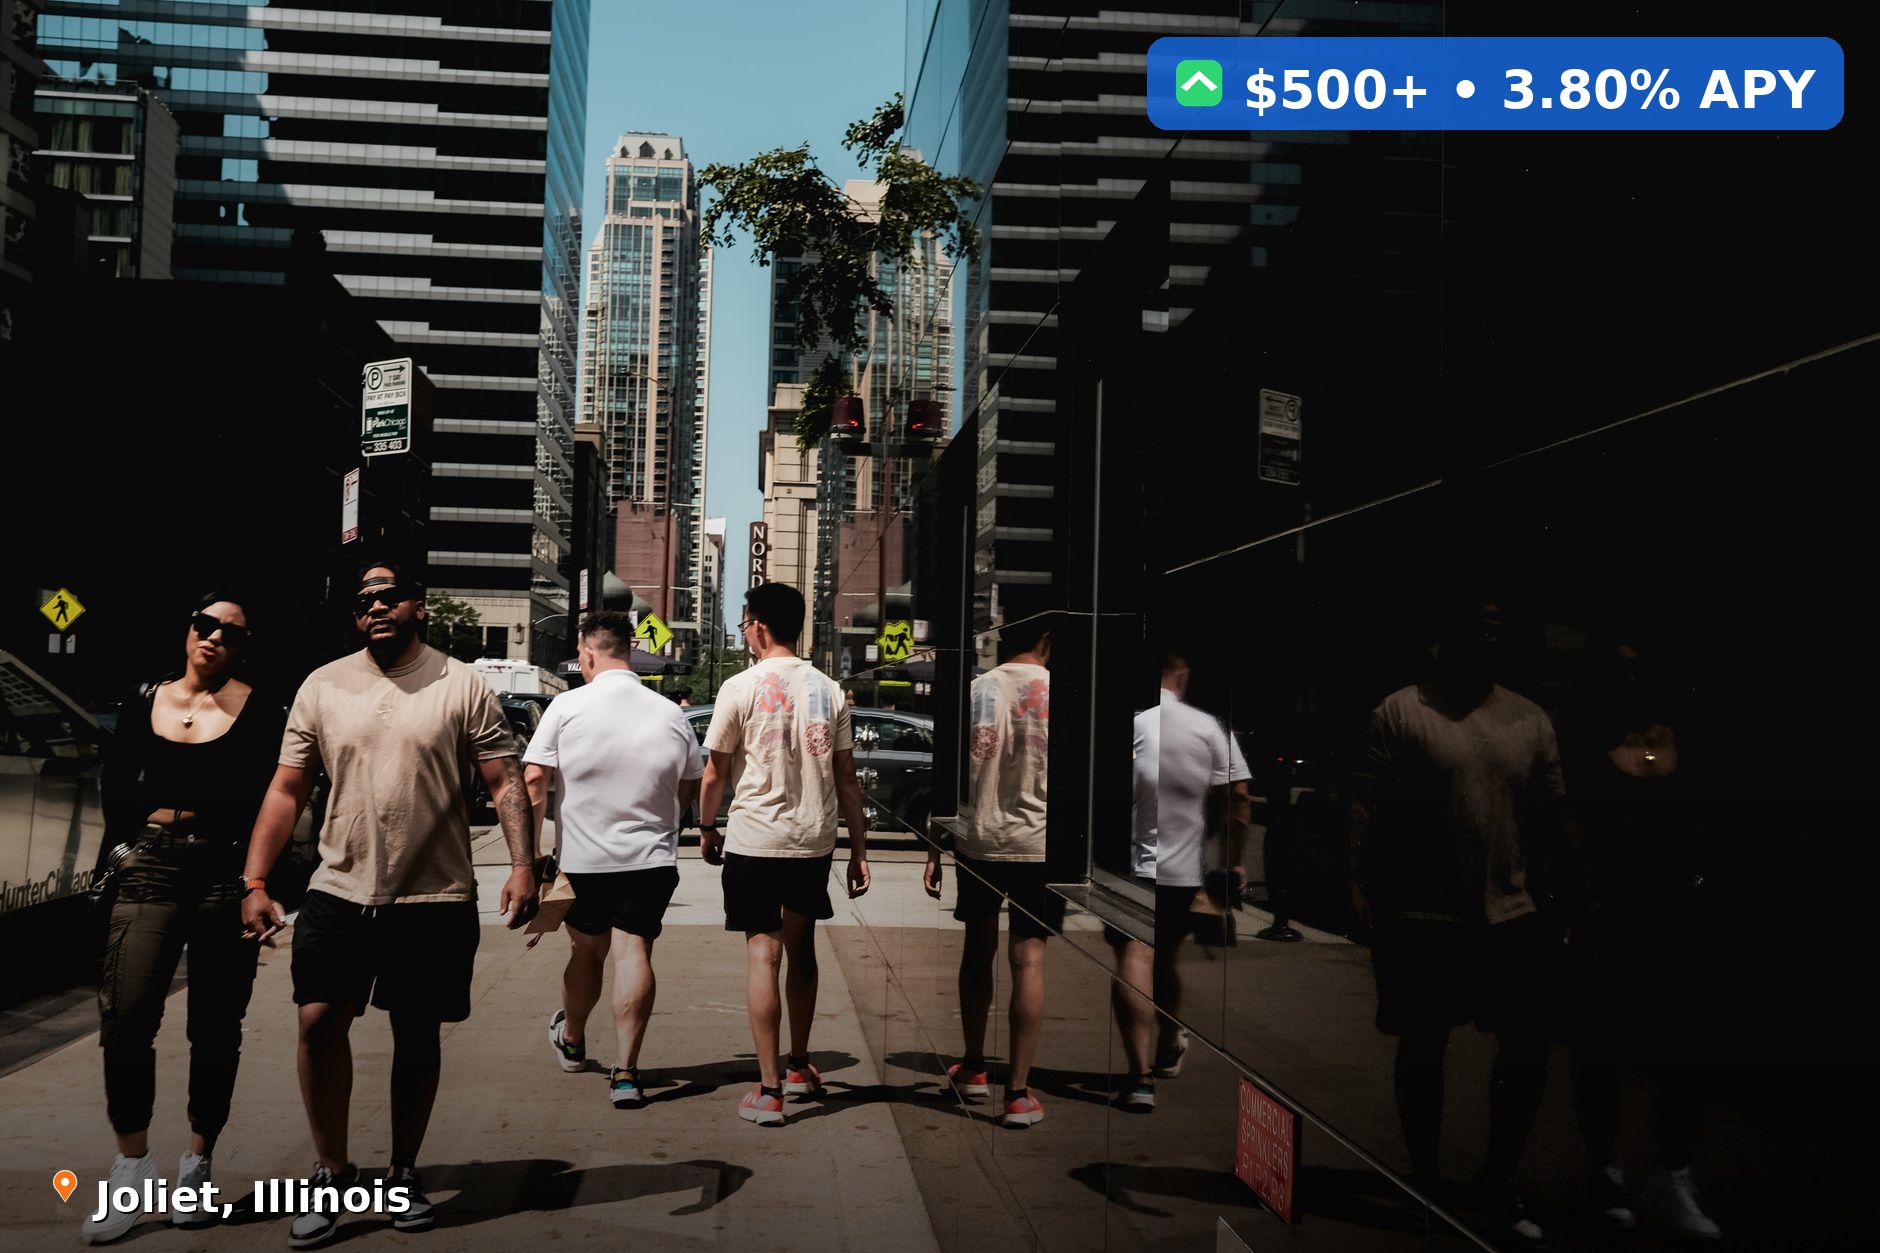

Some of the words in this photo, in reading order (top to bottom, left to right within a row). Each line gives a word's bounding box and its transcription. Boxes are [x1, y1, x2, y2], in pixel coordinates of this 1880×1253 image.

[373, 441, 388, 452] 335
[1240, 1084, 1291, 1147] COMMERCIAL
[1241, 1118, 1289, 1179] SPRINKLERS
